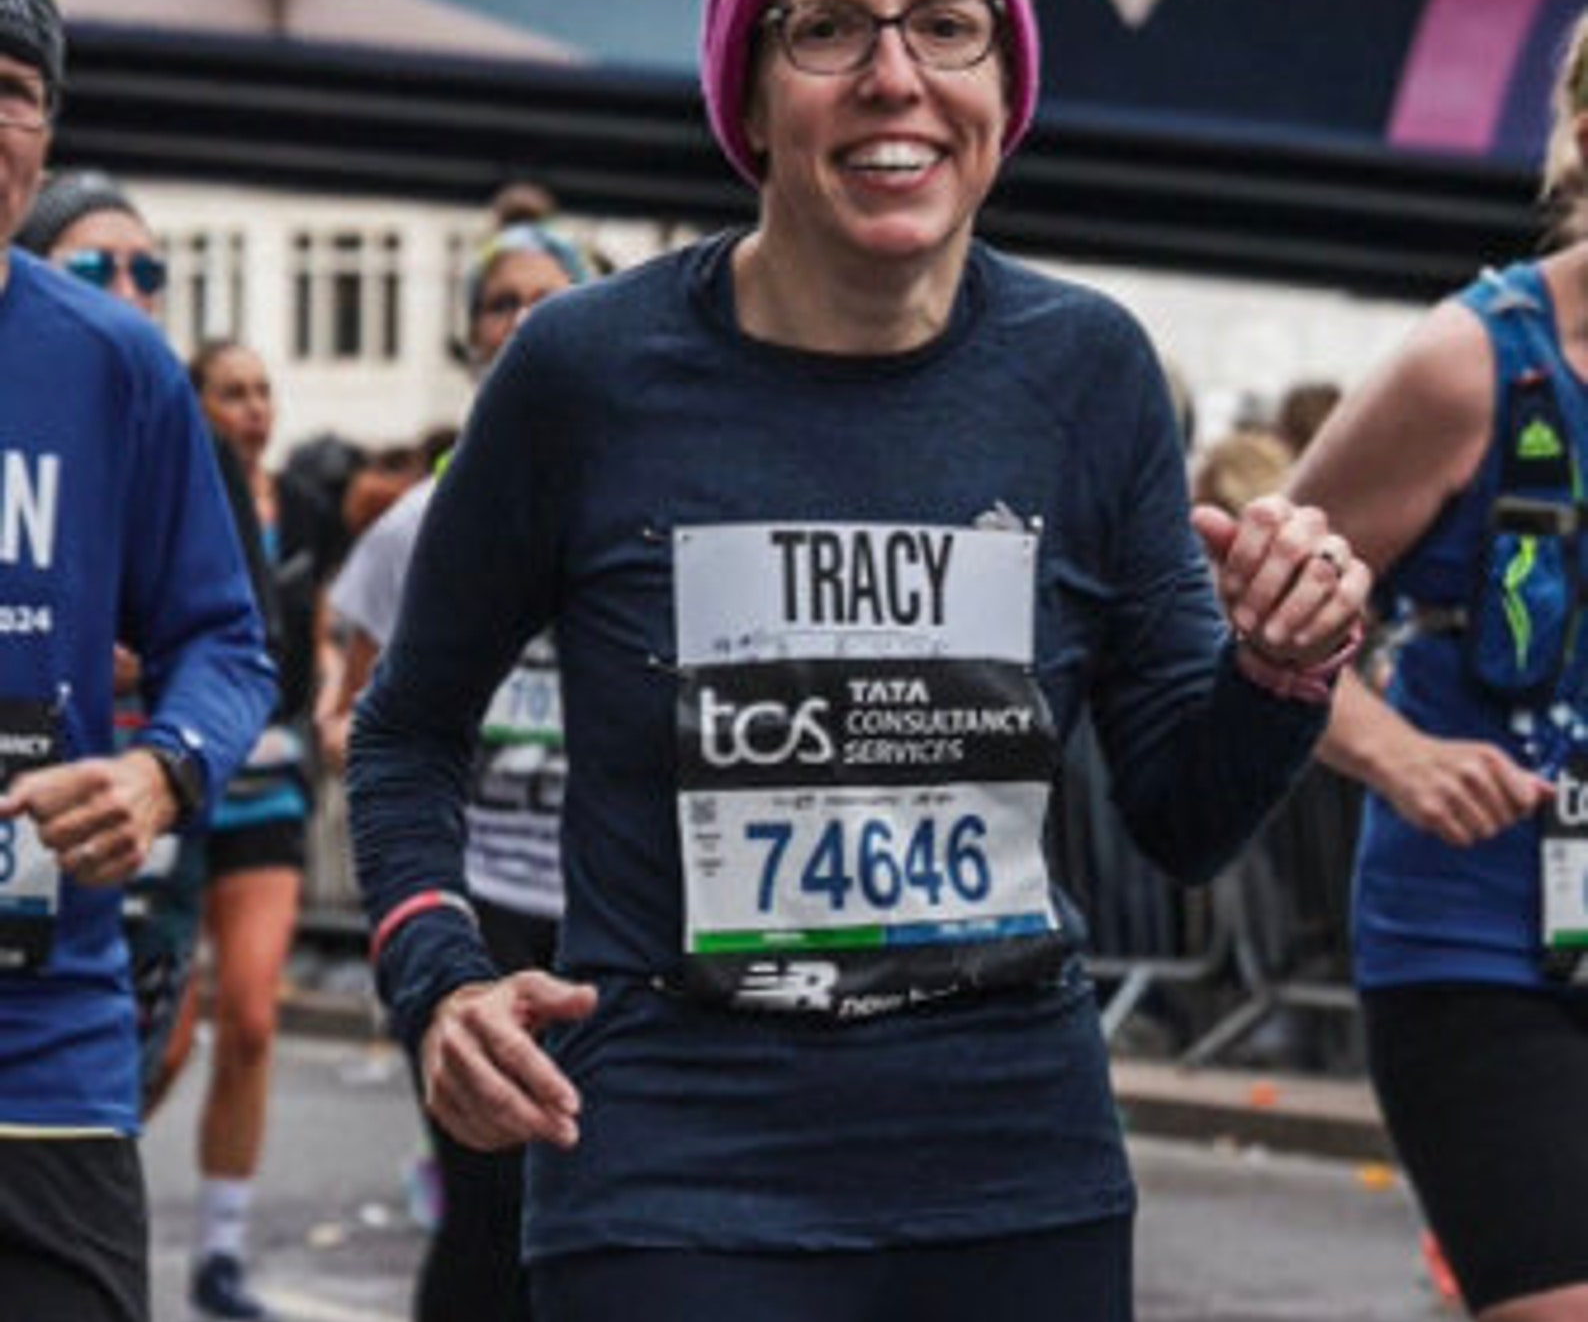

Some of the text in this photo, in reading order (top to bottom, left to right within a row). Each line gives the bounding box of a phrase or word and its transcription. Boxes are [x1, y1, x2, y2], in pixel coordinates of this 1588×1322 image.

[771, 529, 954, 626] TRACY
[848, 678, 930, 704] TATA
[699, 686, 834, 766] tcs
[846, 706, 1034, 736] CONSULTANCY
[843, 738, 965, 765] SERVICES
[745, 814, 992, 913] 74646
